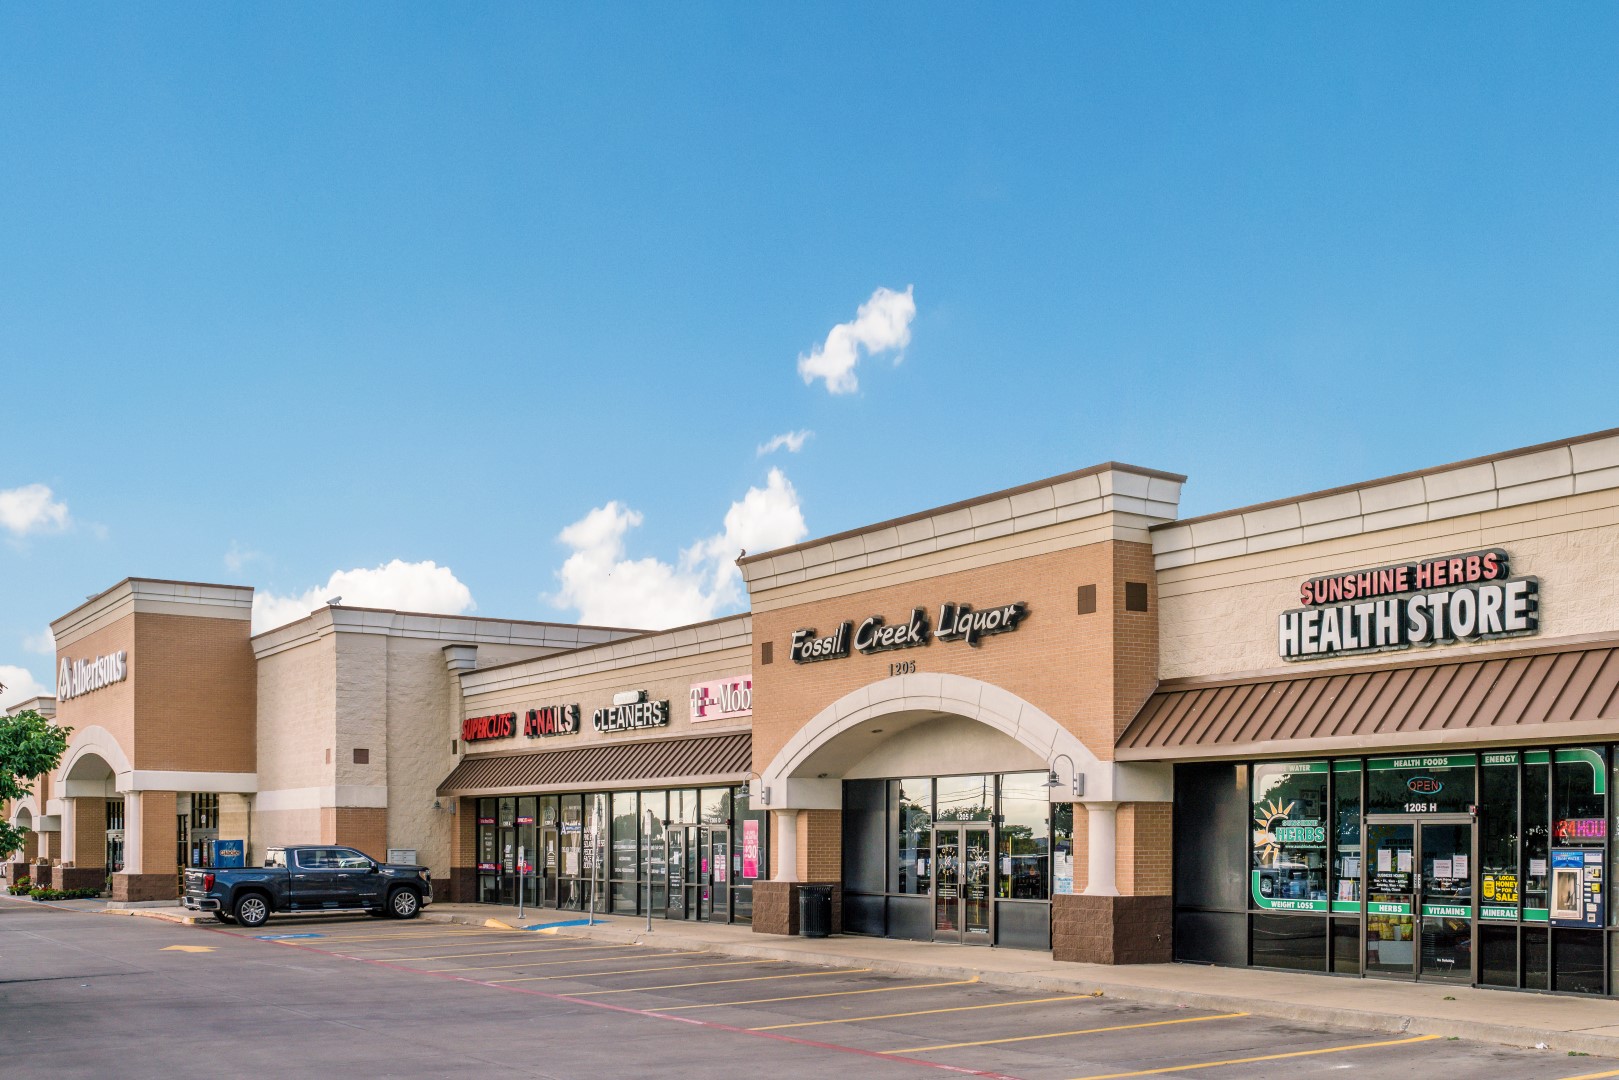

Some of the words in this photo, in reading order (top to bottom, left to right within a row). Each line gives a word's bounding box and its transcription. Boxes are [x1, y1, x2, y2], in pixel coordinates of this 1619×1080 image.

[1301, 566, 1409, 605] SUNSHINE
[1416, 552, 1499, 589] HERBS
[1279, 599, 1400, 657] HEALTH
[1408, 580, 1529, 642] STORE
[790, 622, 846, 661] Fossil
[853, 609, 923, 651] Creek
[934, 604, 1017, 643] Liquor
[71, 649, 126, 698] Albertsons
[888, 660, 916, 677] 1205
[523, 704, 575, 737] A-NAILS
[593, 700, 662, 732] CLEANERS
[462, 713, 513, 742] SUPERCUTS
[1484, 755, 1516, 763] ENERGY
[1409, 780, 1439, 791] OPEN
[1404, 803, 1427, 812] 1205
[1430, 803, 1437, 812] H
[1276, 827, 1325, 842] HERBS
[1577, 820, 1605, 837] HOU
[1495, 893, 1518, 902] SALE
[1429, 907, 1465, 915] VITAMINS
